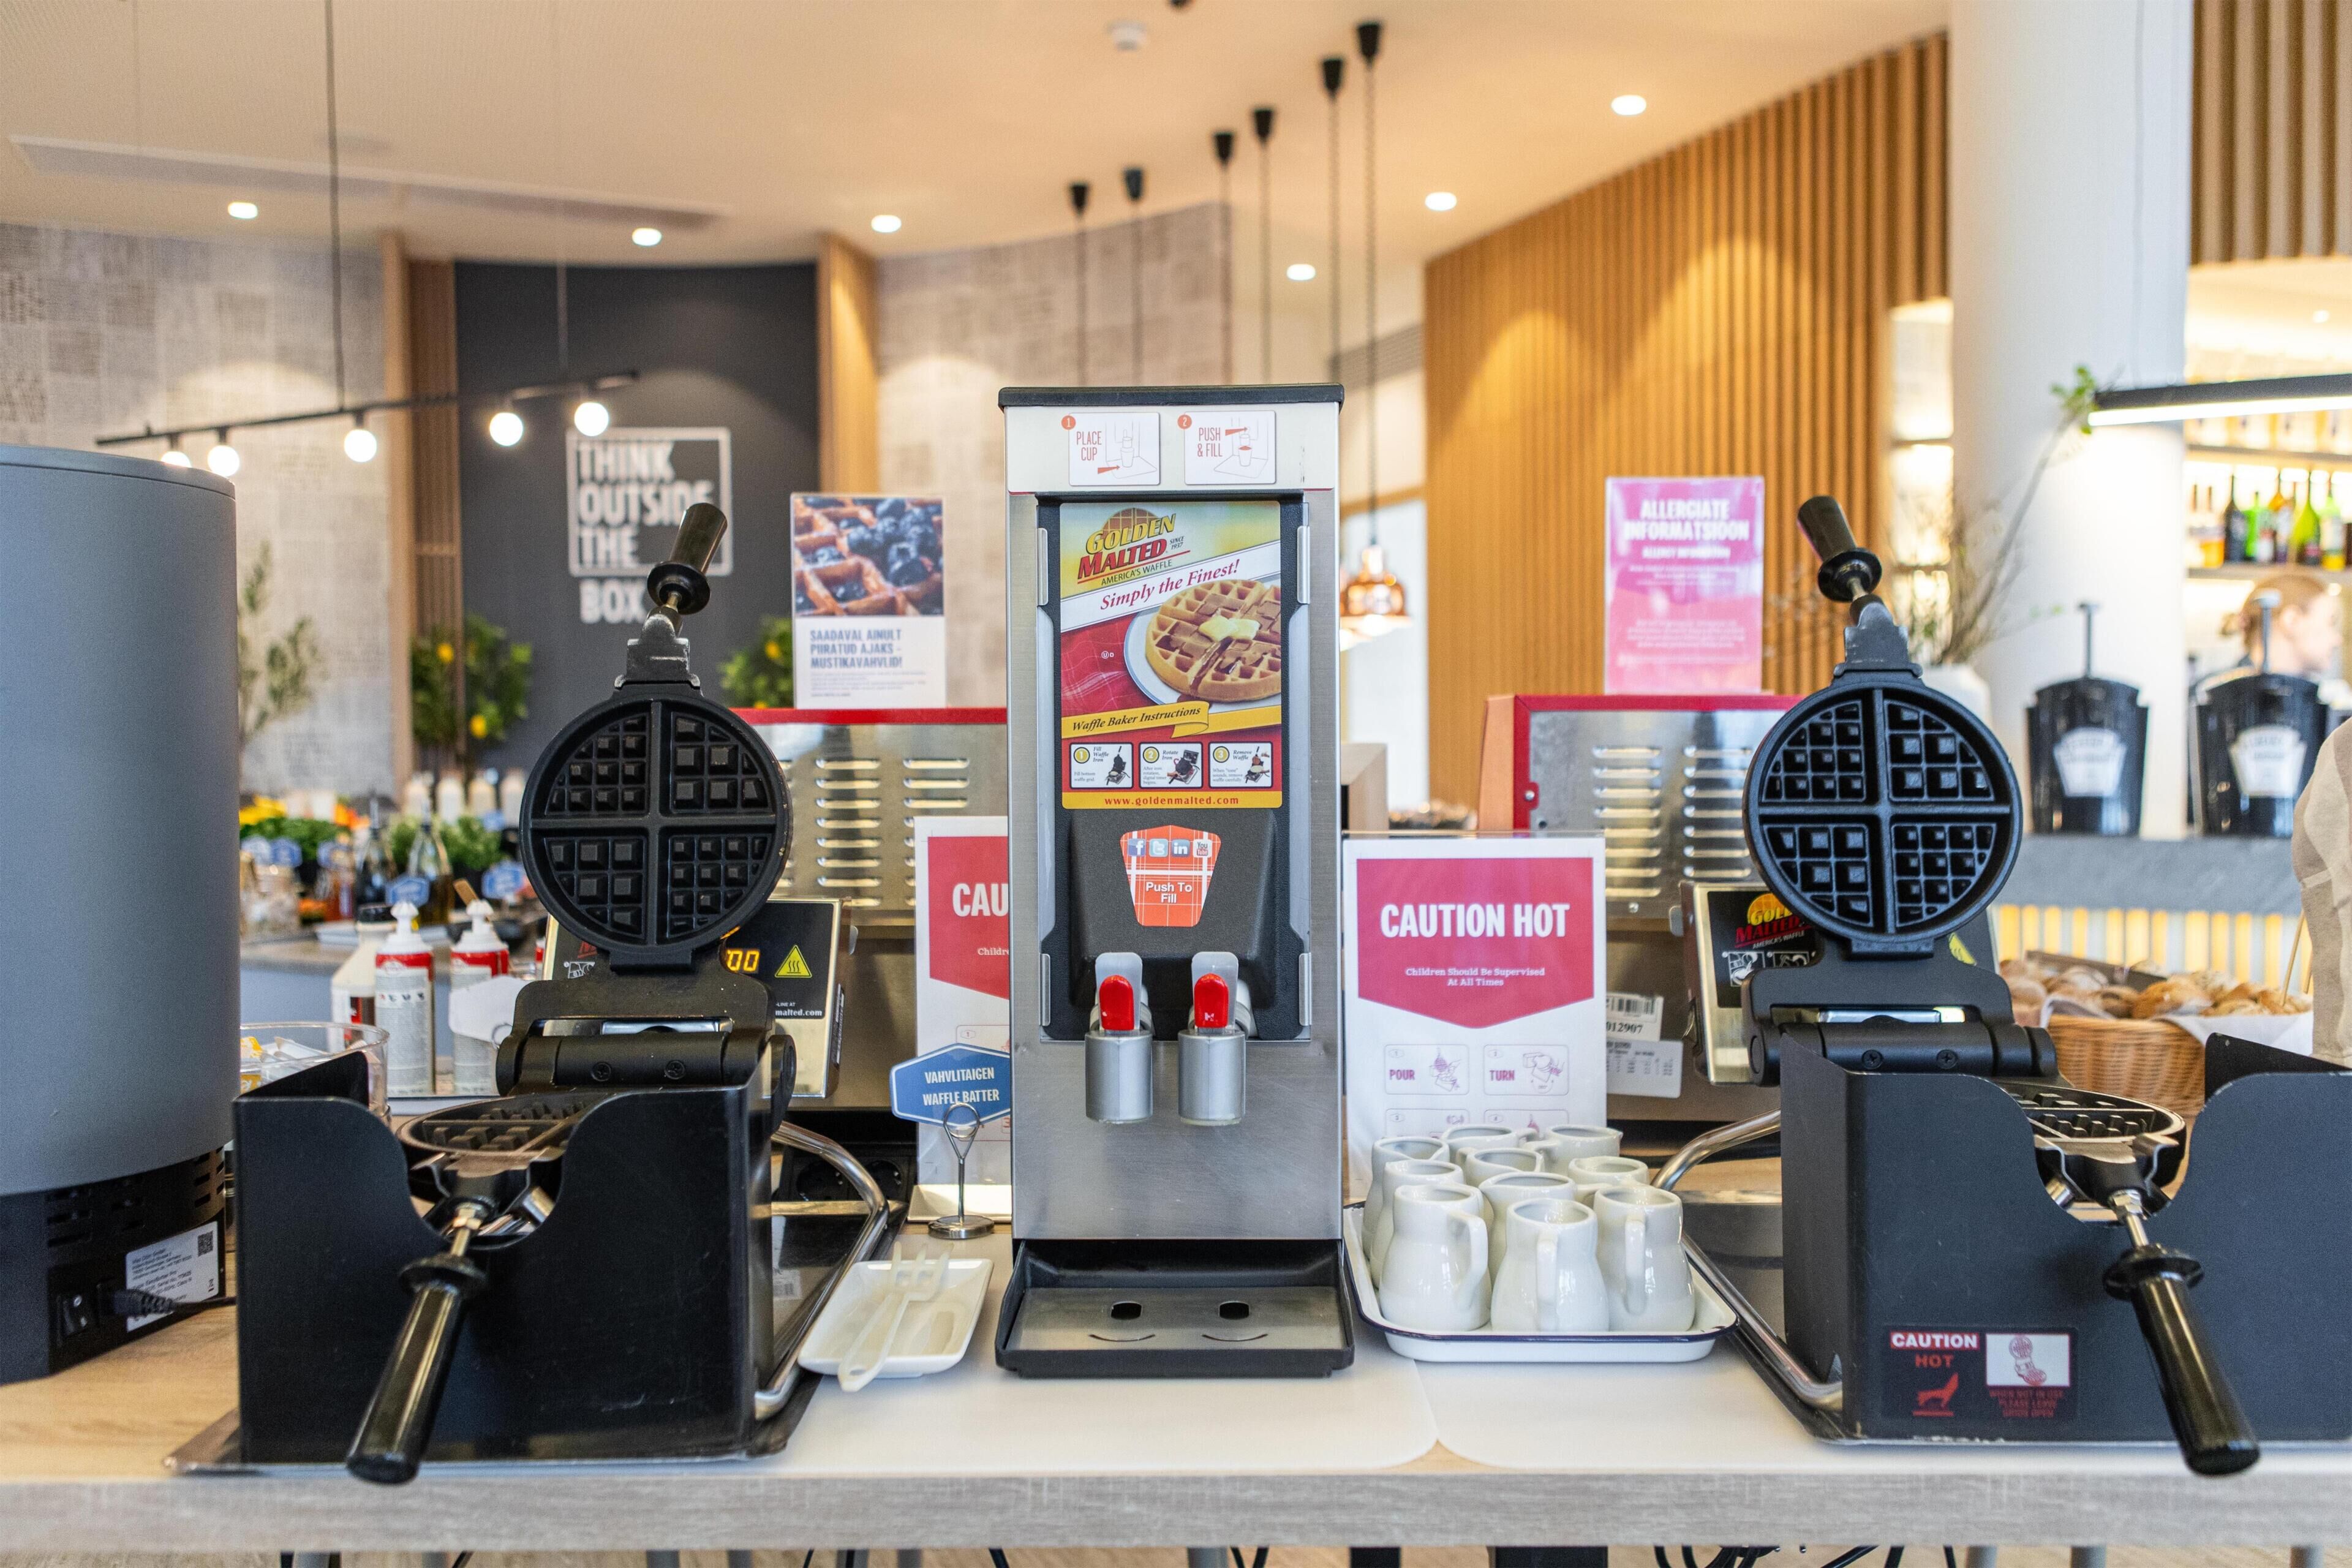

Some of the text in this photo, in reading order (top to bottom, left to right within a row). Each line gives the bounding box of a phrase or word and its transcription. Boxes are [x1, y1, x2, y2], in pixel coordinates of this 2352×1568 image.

[1077, 431, 1102, 445] PLACE
[1199, 428, 1221, 442] PUSH
[1081, 447, 1098, 461] CUP
[1197, 443, 1223, 457] & FILL
[578, 441, 676, 482] THINK
[1086, 513, 1177, 554] GOLDEN
[1170, 536, 1185, 545] SINCE
[579, 526, 639, 568] THE
[1077, 538, 1167, 579] MALTED
[1101, 559, 1172, 586] AMERICA'S WAFFLE
[1100, 559, 1240, 610] Simply the Finest!
[581, 579, 648, 624] BOX
[810, 629, 902, 641] SAADAVAL AINULT
[810, 643, 857, 655] PIIRATUD
[861, 643, 894, 655] AJAKS
[811, 657, 902, 669] MUSTIKAVAHVLID!
[1072, 706, 1202, 732] Waffle Baker Instructions
[1104, 796, 1239, 806] www.goldenmalted.com
[1145, 881, 1193, 892] Push To
[952, 883, 1009, 917] CAU
[1161, 893, 1177, 903] Fill
[1381, 903, 1570, 938] CAUTION HOT
[1736, 916, 1800, 943] MALTED
[1783, 930, 1804, 941] WAFFLE
[978, 947, 1009, 956] Childre
[1406, 968, 1545, 978] Children Should Be Supervised
[924, 1067, 995, 1084] VAHVLITAIGEN
[1389, 1069, 1415, 1080] POUR
[1490, 1070, 1515, 1081] TURN
[922, 1089, 1000, 1106] WAFFLE BATTER
[1892, 1333, 1977, 1348] CAUTION
[1915, 1354, 1954, 1368] HOT
